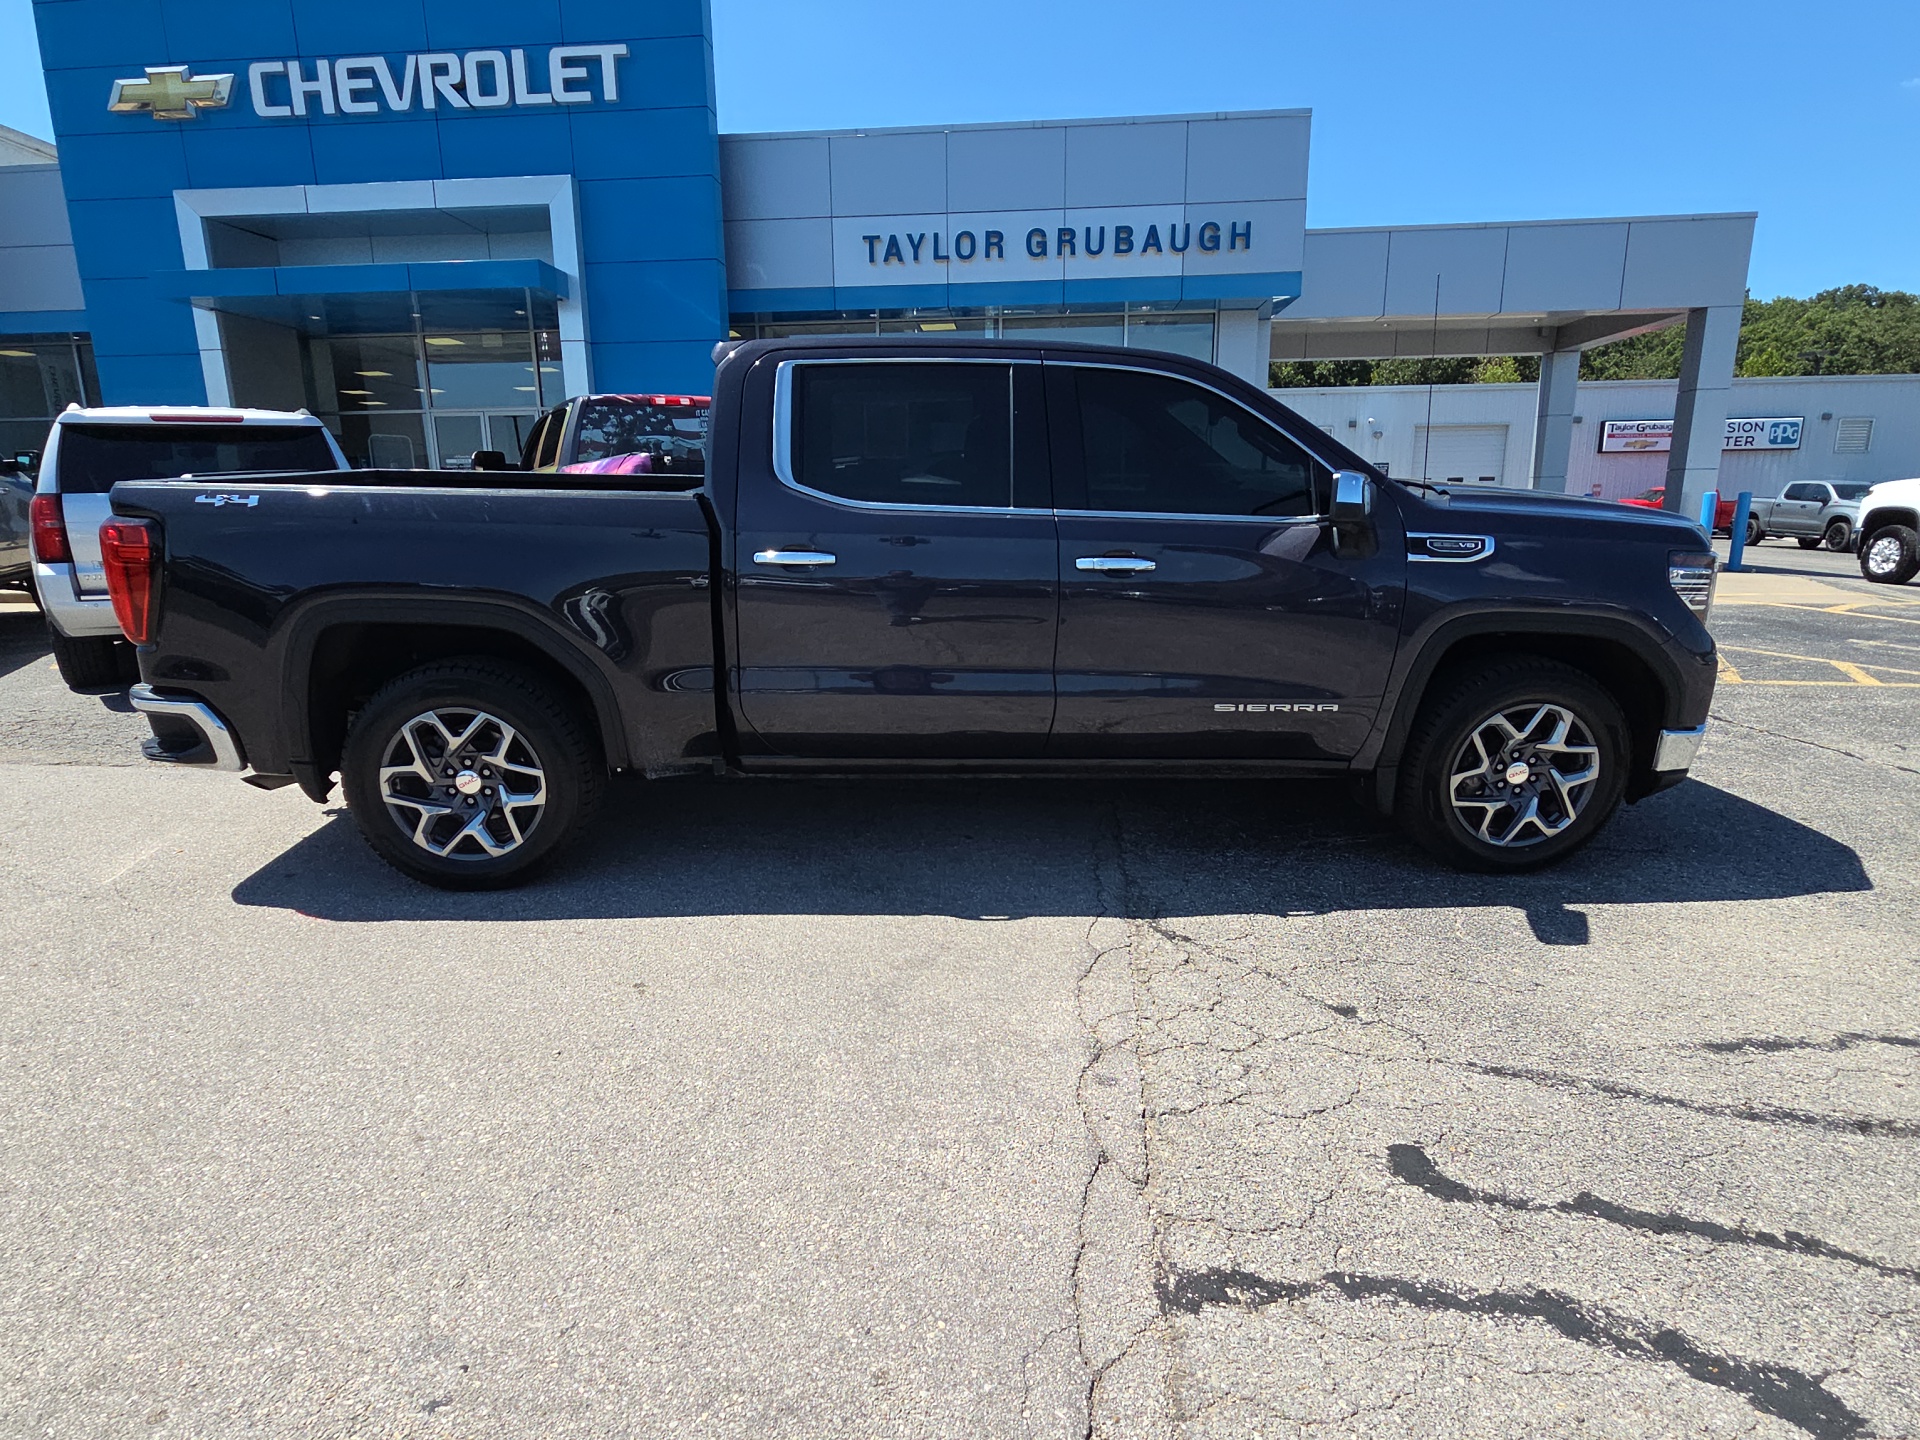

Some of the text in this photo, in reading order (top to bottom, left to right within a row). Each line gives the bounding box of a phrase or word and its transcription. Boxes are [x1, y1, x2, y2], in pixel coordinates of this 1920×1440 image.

[249, 43, 630, 118] CHEVROLET
[862, 221, 1253, 264] TAYLOR GRUBAUGH
[1608, 422, 1673, 433] Taylor Grubaug
[1726, 421, 1765, 433] SION
[1770, 424, 1799, 443] PPG
[1724, 435, 1755, 447] TER
[1213, 703, 1339, 712] SIERRA
[1509, 769, 1527, 778] GMC
[459, 777, 478, 788] GMC
